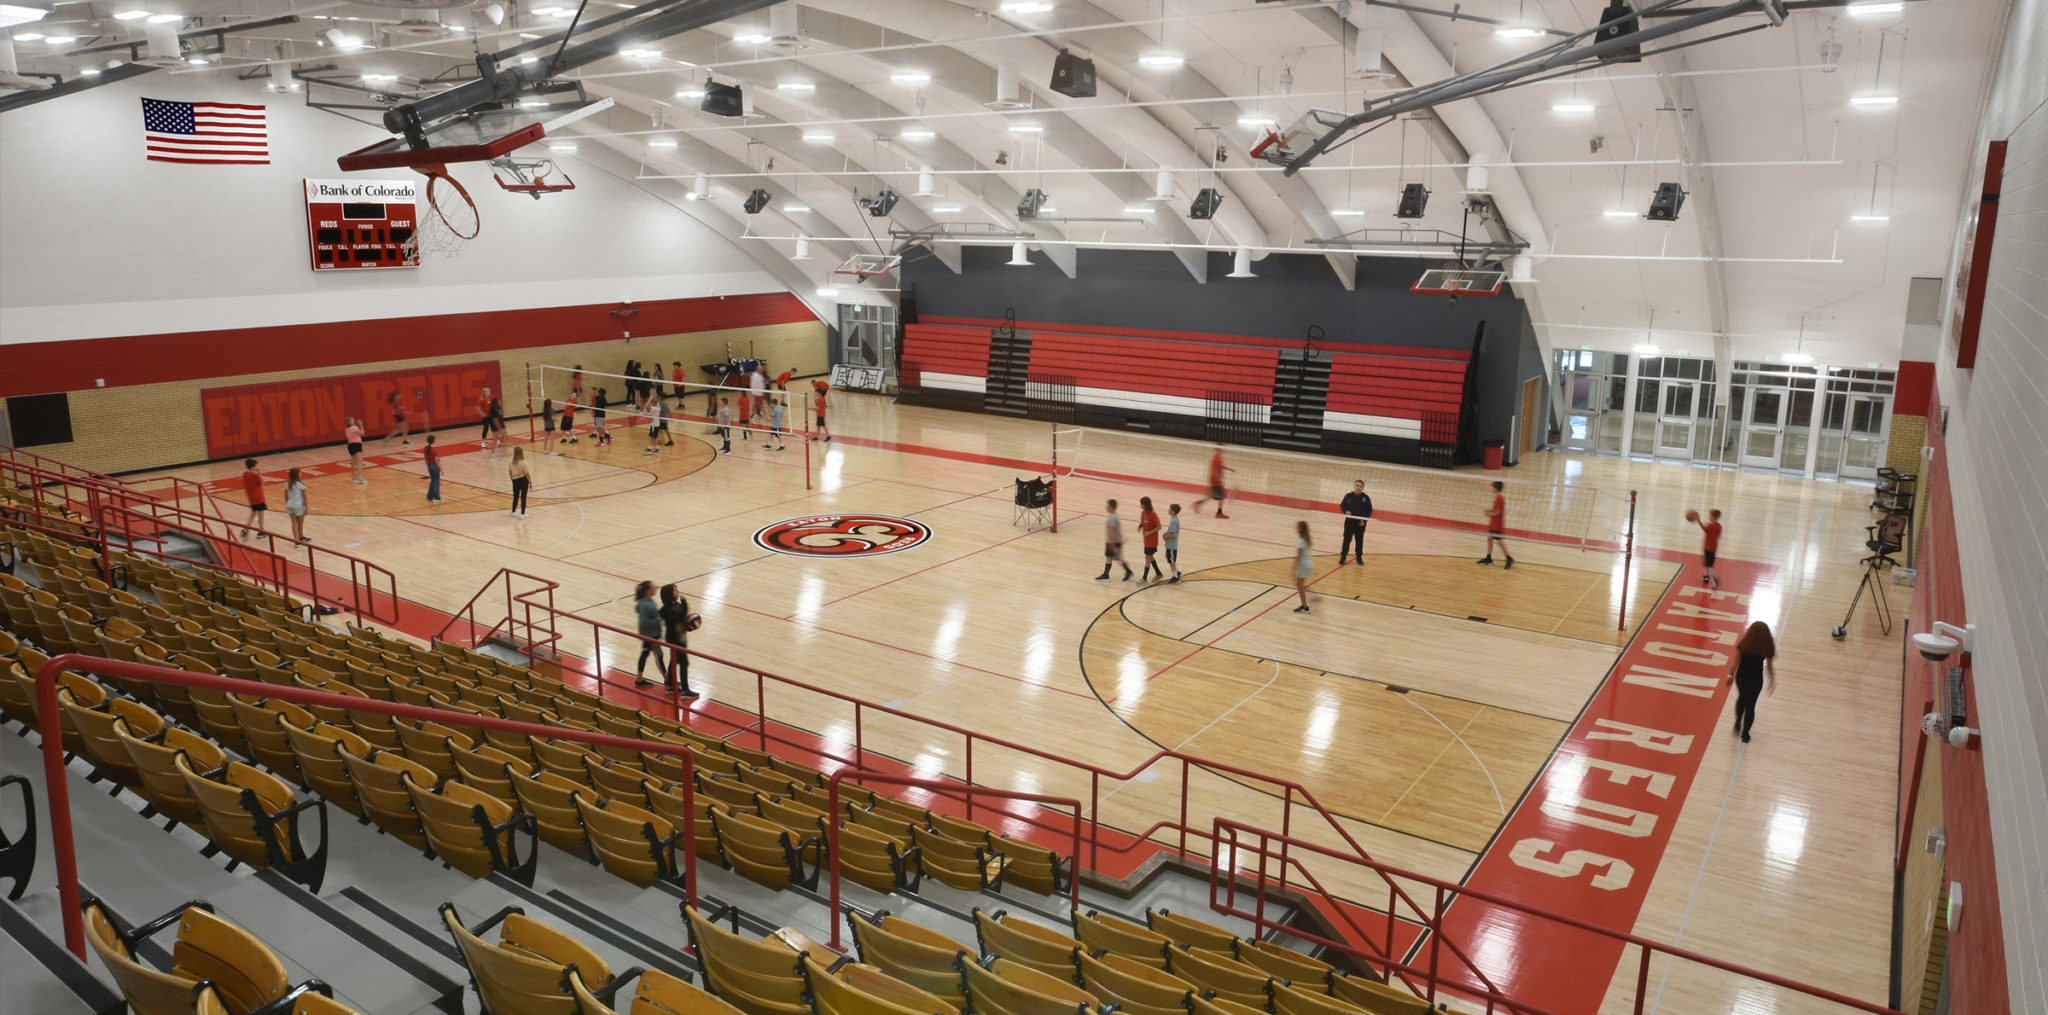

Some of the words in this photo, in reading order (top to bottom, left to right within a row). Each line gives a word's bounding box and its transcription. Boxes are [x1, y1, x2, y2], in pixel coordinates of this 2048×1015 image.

[320, 184, 349, 196] Bank
[351, 184, 363, 196] of
[365, 185, 415, 197] Colorado
[320, 220, 338, 228] REDS
[390, 220, 411, 228] GUEST
[202, 385, 347, 448] EATON
[360, 368, 487, 430] REDS
[787, 515, 841, 527] EATON
[1622, 585, 1752, 699] EATON
[1508, 718, 1695, 891] REDS
